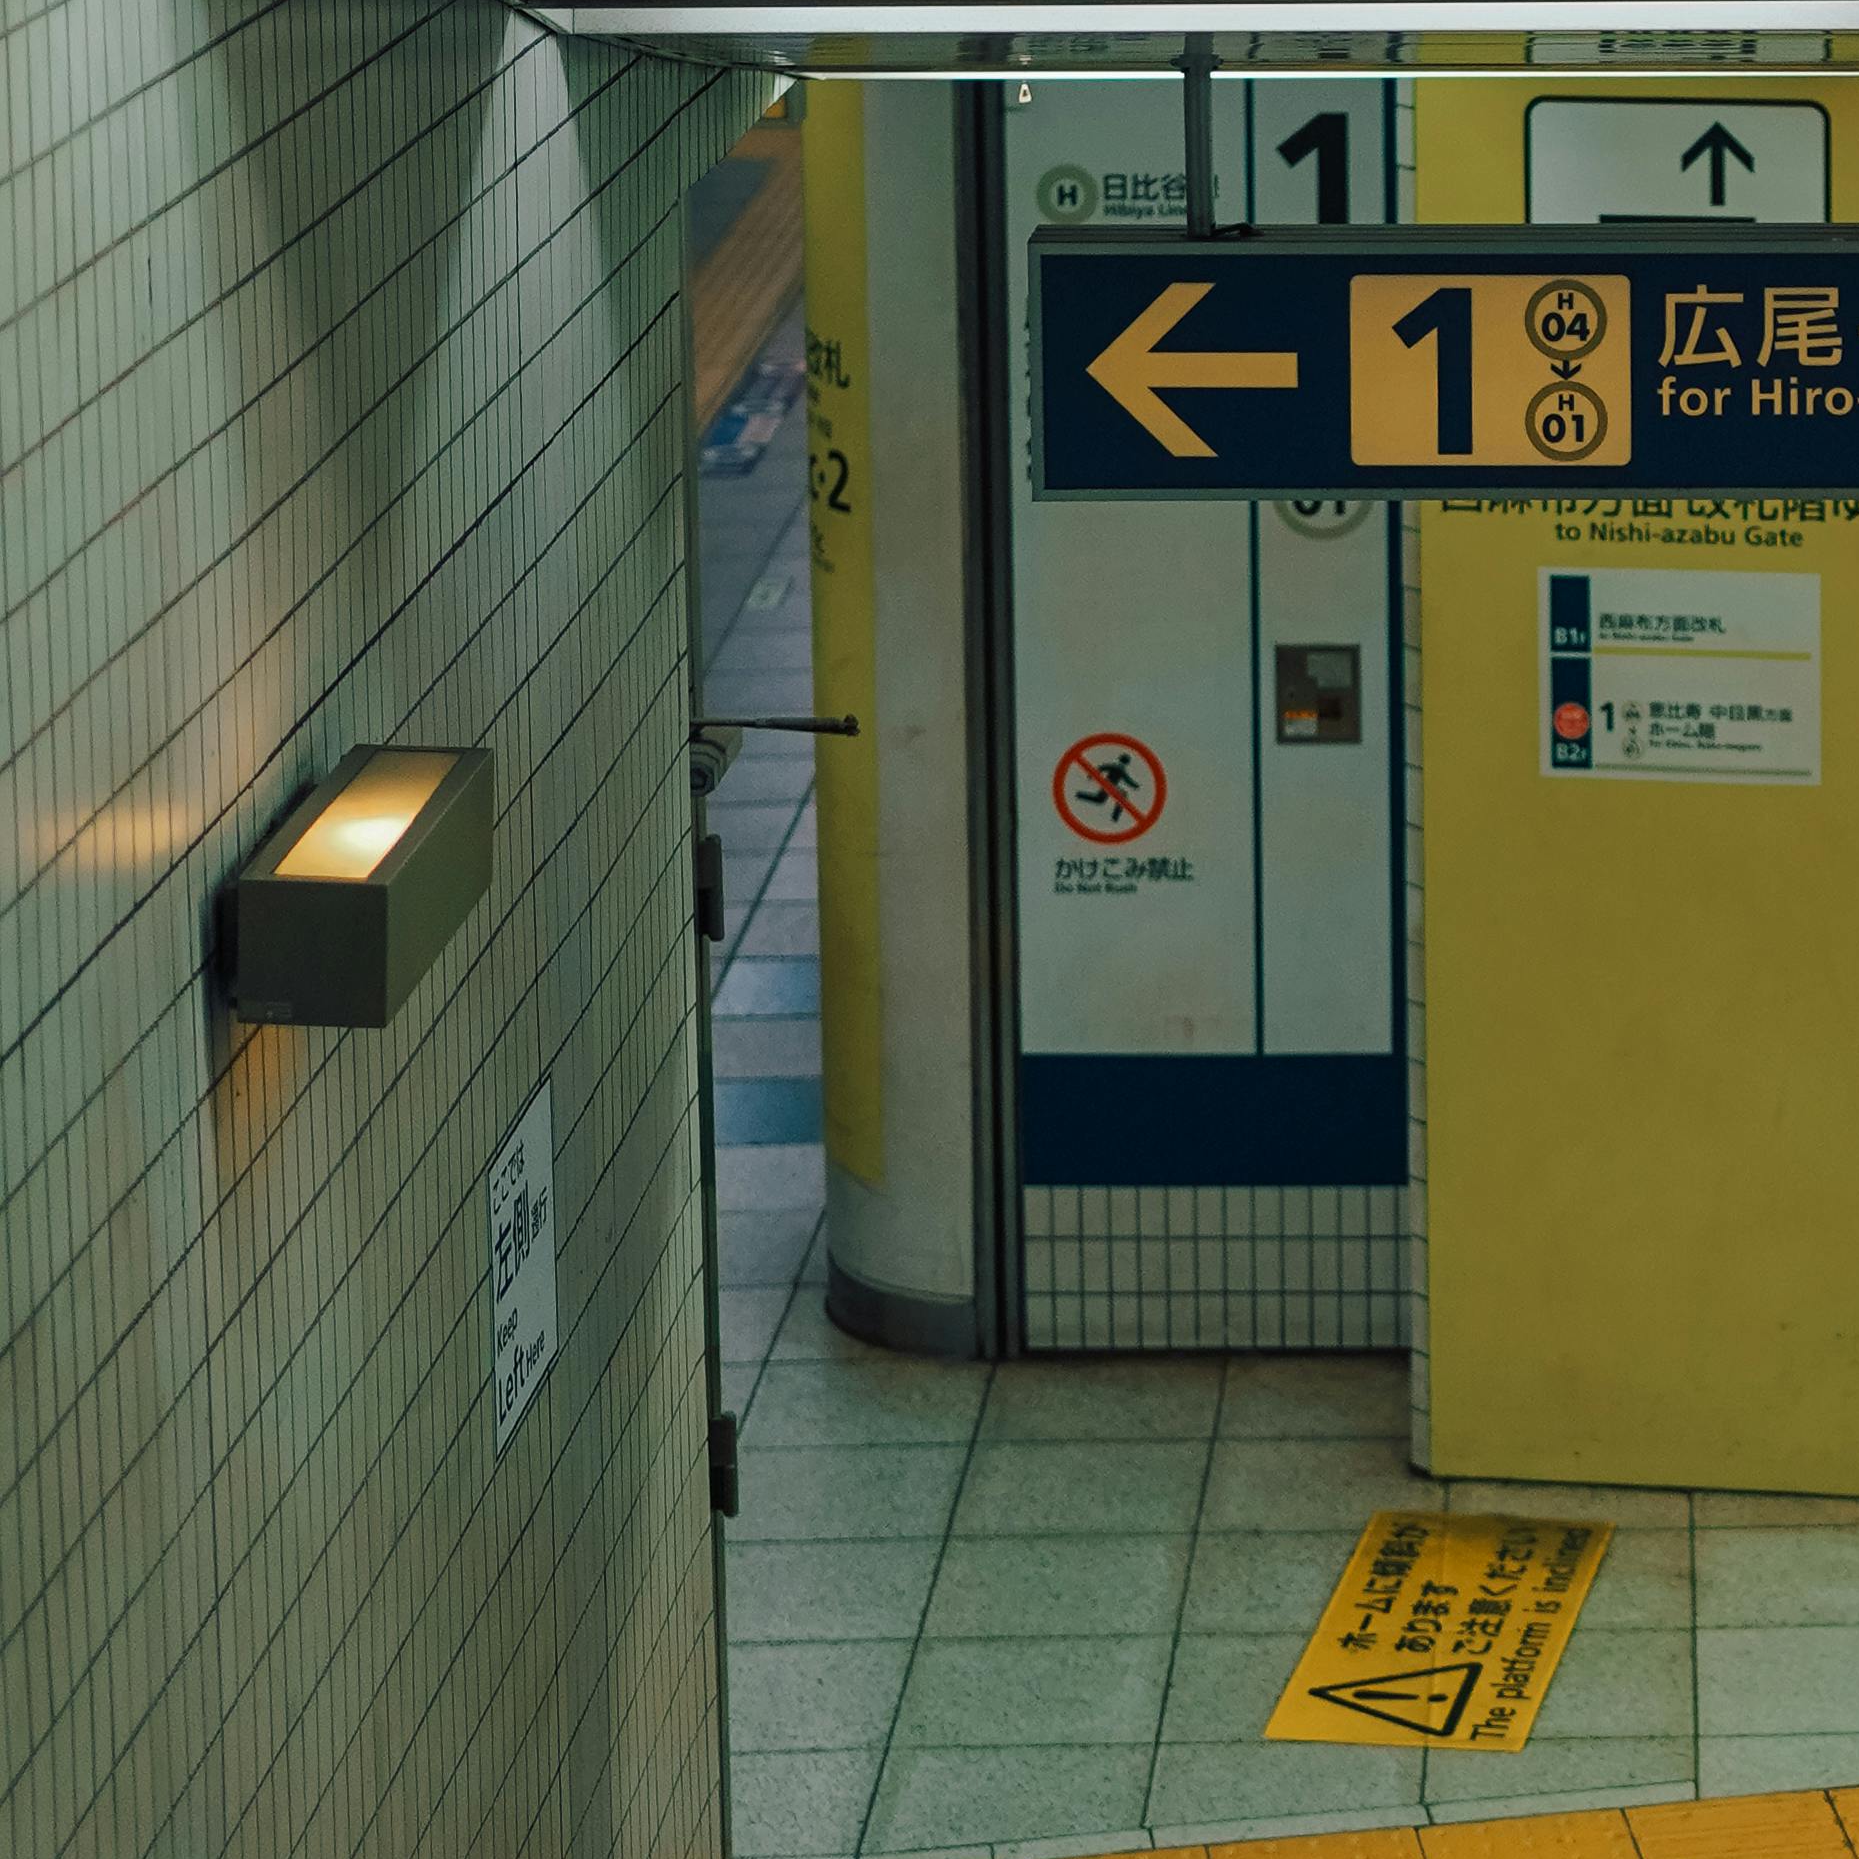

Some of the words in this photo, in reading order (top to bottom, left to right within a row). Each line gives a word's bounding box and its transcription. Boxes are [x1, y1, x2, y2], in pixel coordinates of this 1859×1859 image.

[1103, 173, 1220, 201] 日比谷
[1558, 293, 1574, 310] H
[1541, 312, 1590, 342] 04
[1392, 288, 1472, 454] 1
[1558, 394, 1574, 411] H
[1657, 376, 1731, 416] for
[1542, 414, 1585, 443] 01
[1555, 523, 1581, 541] to
[1590, 524, 1736, 545] Nishi-azabu
[1745, 526, 1804, 548] Gate
[1600, 703, 1614, 731] 1
[493, 1139, 525, 1215] ここでは
[496, 1308, 518, 1355] Keep
[499, 1345, 525, 1427] Left
[526, 1330, 545, 1378] Here
[1522, 1599, 1562, 1615] is
[1491, 1619, 1553, 1701] platform
[1470, 1706, 1517, 1741] The
